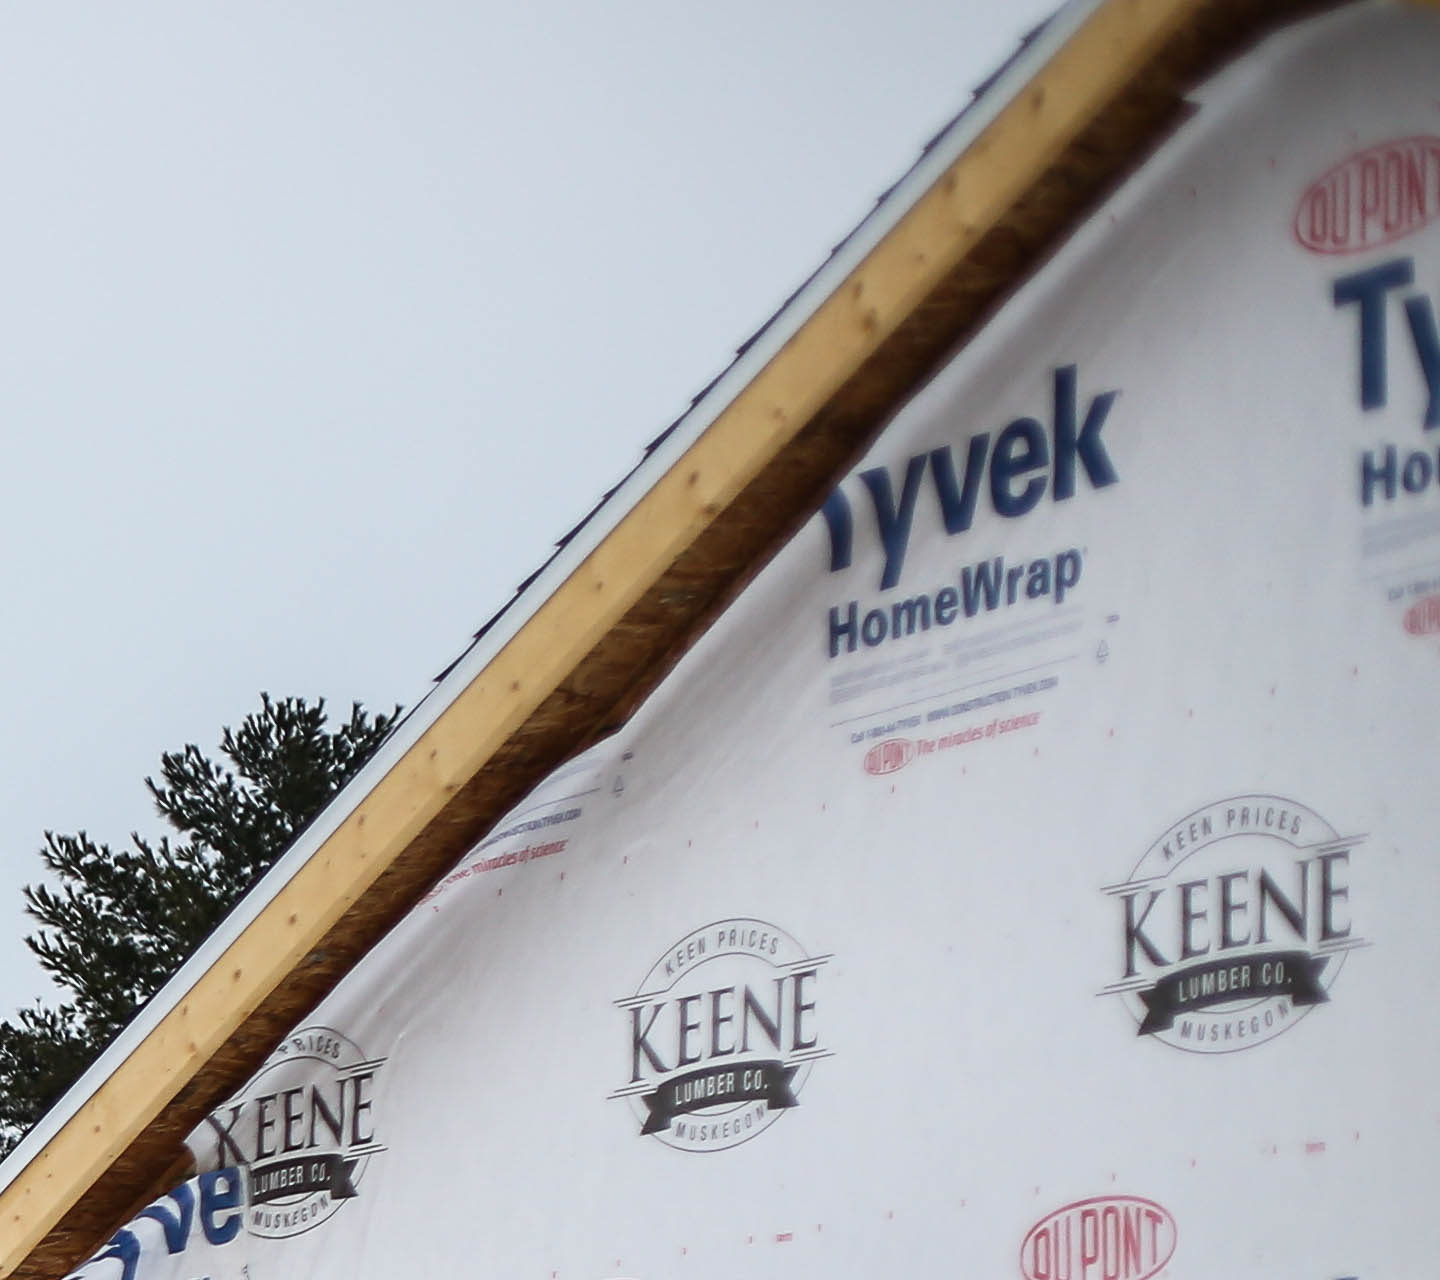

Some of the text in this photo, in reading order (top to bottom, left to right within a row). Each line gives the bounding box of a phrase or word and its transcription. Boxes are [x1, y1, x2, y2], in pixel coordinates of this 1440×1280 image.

[826, 546, 1082, 659] HomeWrap
[1162, 806, 1302, 861] KEEN PRICES
[1120, 849, 1352, 979] KEENE
[665, 927, 779, 977] KEEN PRICES
[1179, 962, 1293, 1003] LUMBER CO.
[628, 967, 818, 1085] KEENE
[1181, 999, 1290, 1042] MUSKEGON
[674, 1069, 769, 1106] LUMBER CO.
[206, 1070, 376, 1170] KEENE
[675, 1104, 767, 1143] MUSKEGON
[253, 1163, 332, 1196] LUMBER CO.
[253, 1194, 331, 1227] MUSKEGON
